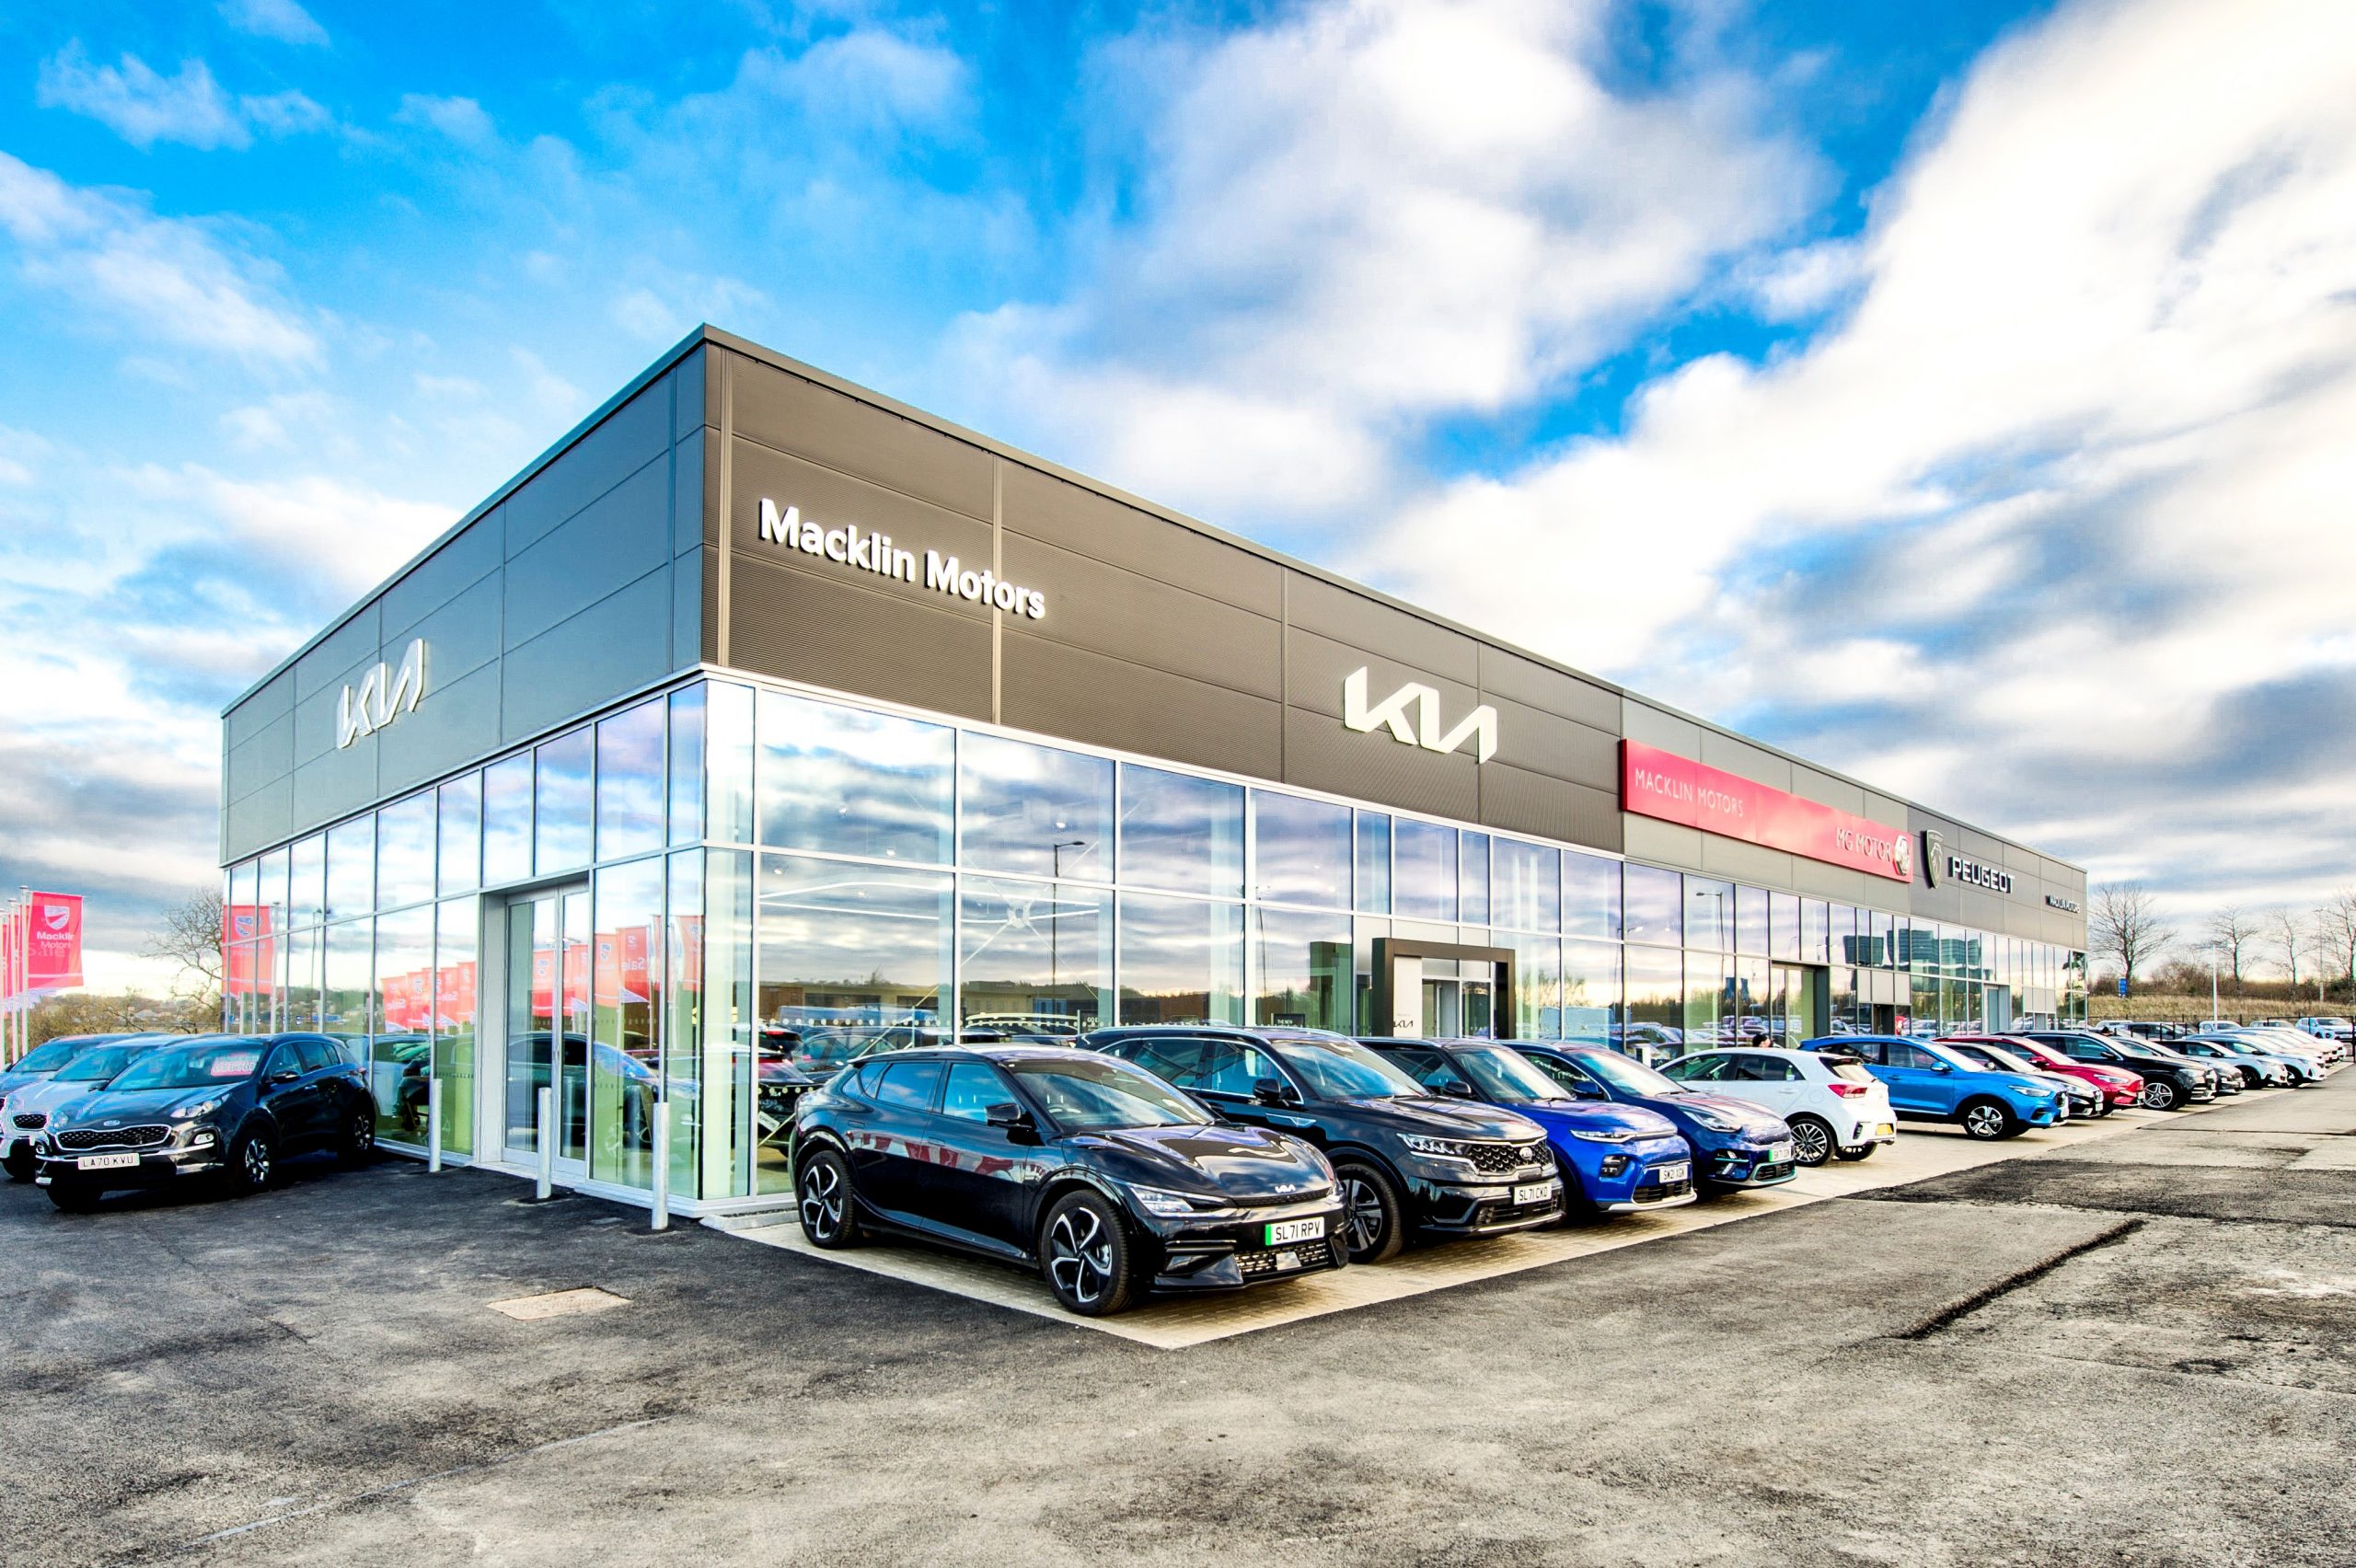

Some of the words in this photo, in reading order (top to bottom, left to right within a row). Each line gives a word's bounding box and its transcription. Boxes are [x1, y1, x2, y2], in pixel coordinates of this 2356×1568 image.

[760, 498, 915, 582] Macklin
[927, 549, 1045, 619] Motors
[1634, 767, 1693, 802] MACKLIN
[1697, 787, 1744, 818] MOTORS
[1836, 827, 1854, 851] MG
[1855, 833, 1891, 862] MOTOR
[1951, 856, 2015, 894] PEUGEOT
[83, 1157, 110, 1168] LA70
[112, 1156, 133, 1165] KVU
[1519, 1188, 1535, 1202] SL71
[1276, 1224, 1299, 1241] SL71
[1300, 1220, 1321, 1238] RPV
